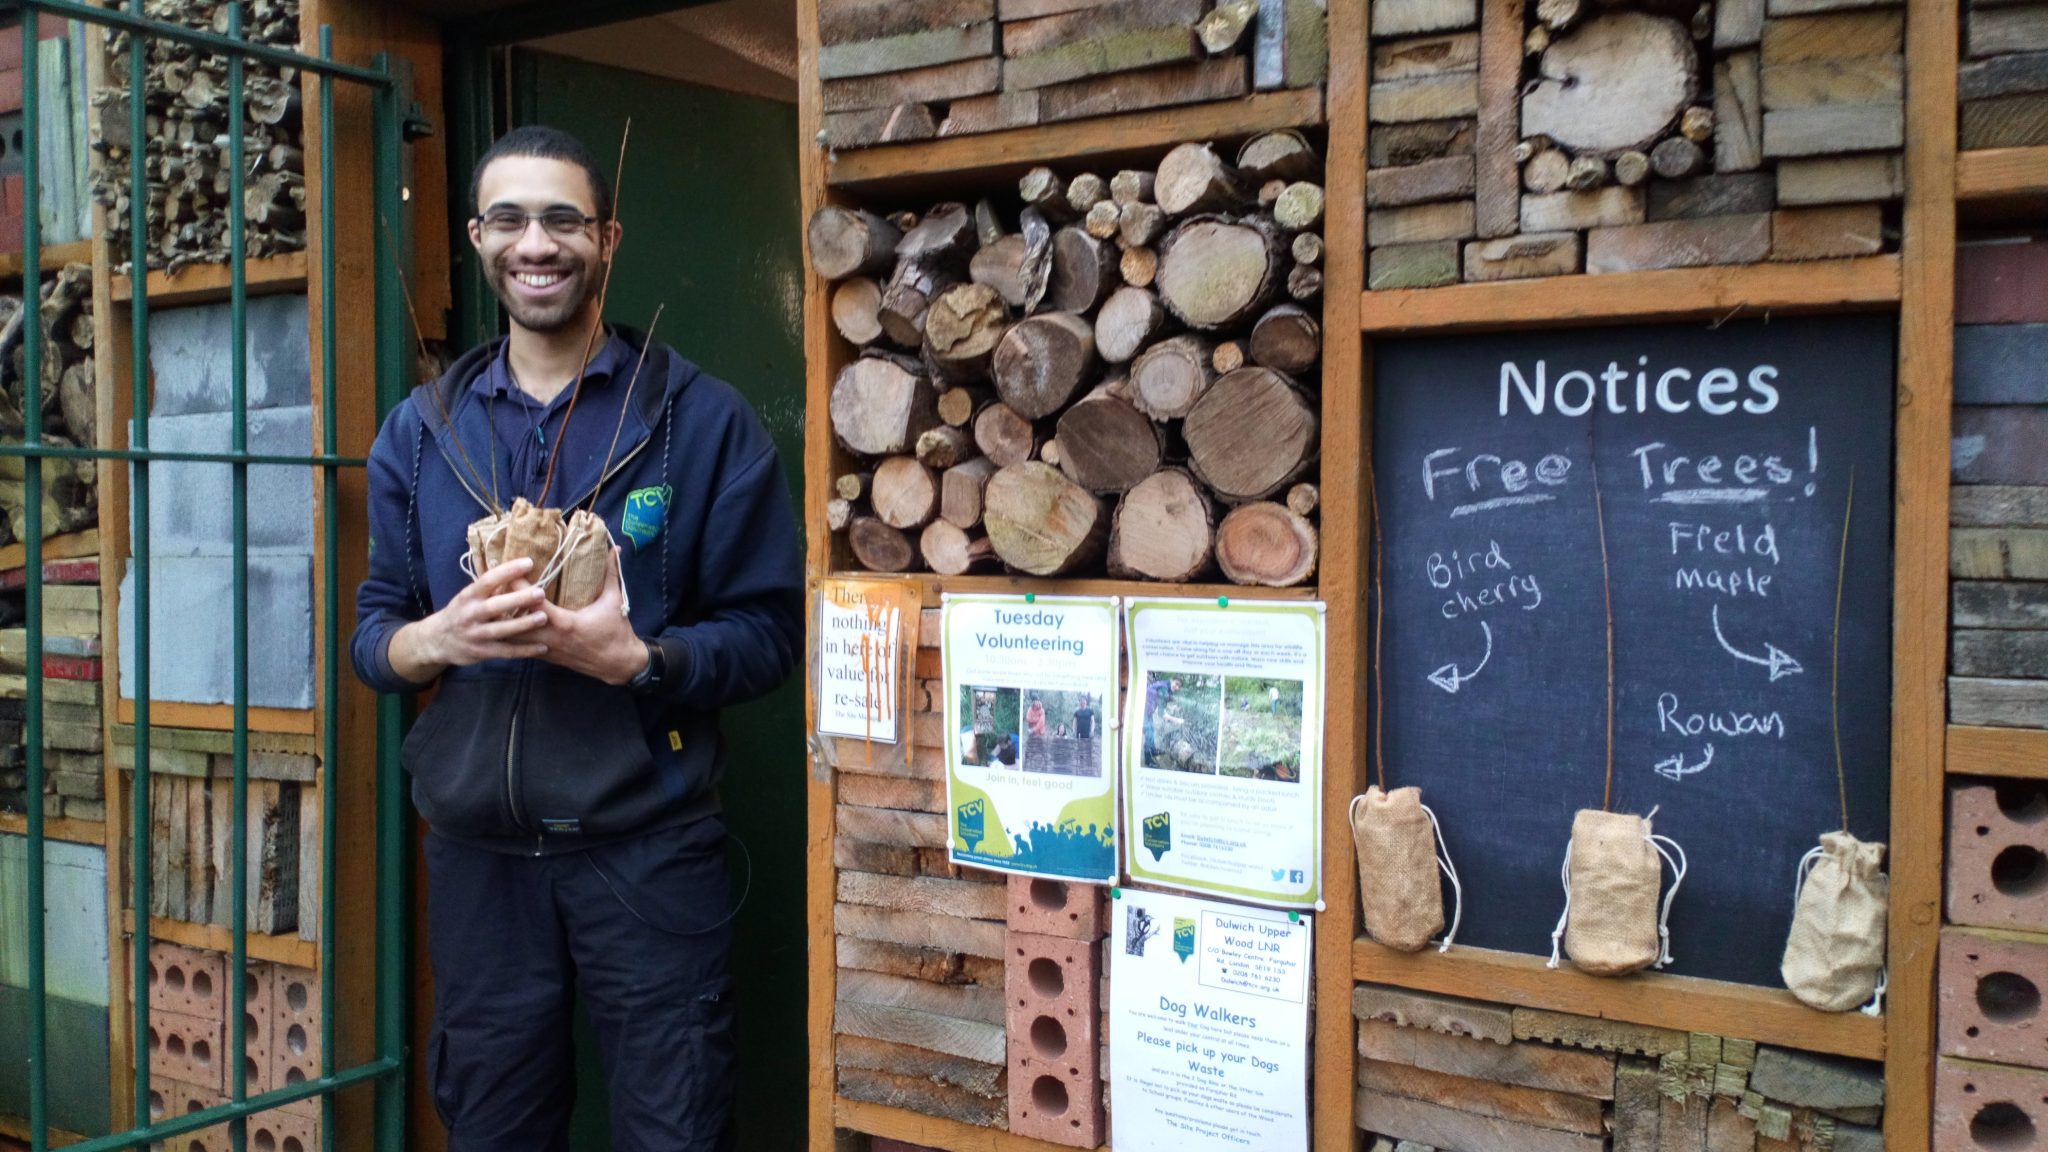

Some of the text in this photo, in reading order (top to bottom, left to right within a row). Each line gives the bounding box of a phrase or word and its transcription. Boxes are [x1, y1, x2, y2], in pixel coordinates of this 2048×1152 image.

[1499, 355, 1779, 417] Notices
[1422, 426, 1819, 500] Free Trees!
[1668, 521, 1780, 565] Field
[1426, 540, 1511, 589] Bird
[832, 586, 873, 604] Ther
[1441, 574, 1542, 610] cherry
[832, 613, 887, 636] nothing
[994, 609, 1064, 630] Tuesday
[826, 637, 895, 659] in here of
[976, 632, 1084, 656] Volunteering
[827, 664, 866, 683] value
[835, 692, 882, 709] re-sale
[1657, 692, 1785, 739] Rowan
[986, 772, 1005, 784] Join
[1022, 776, 1041, 787] feel
[1044, 779, 1073, 791] good
[960, 799, 983, 819] TCV
[1144, 812, 1169, 830] TCV
[1175, 925, 1195, 939] TCV
[1216, 918, 1292, 938] Dulwich Upper
[1224, 935, 1280, 953] Wood LNR
[1160, 995, 1257, 1029] Dog Walkers
[1137, 1030, 1280, 1073] Please pick up your Dogs
[1188, 1058, 1225, 1078] Waste
[1166, 1118, 1251, 1146] The Site Project Officers
